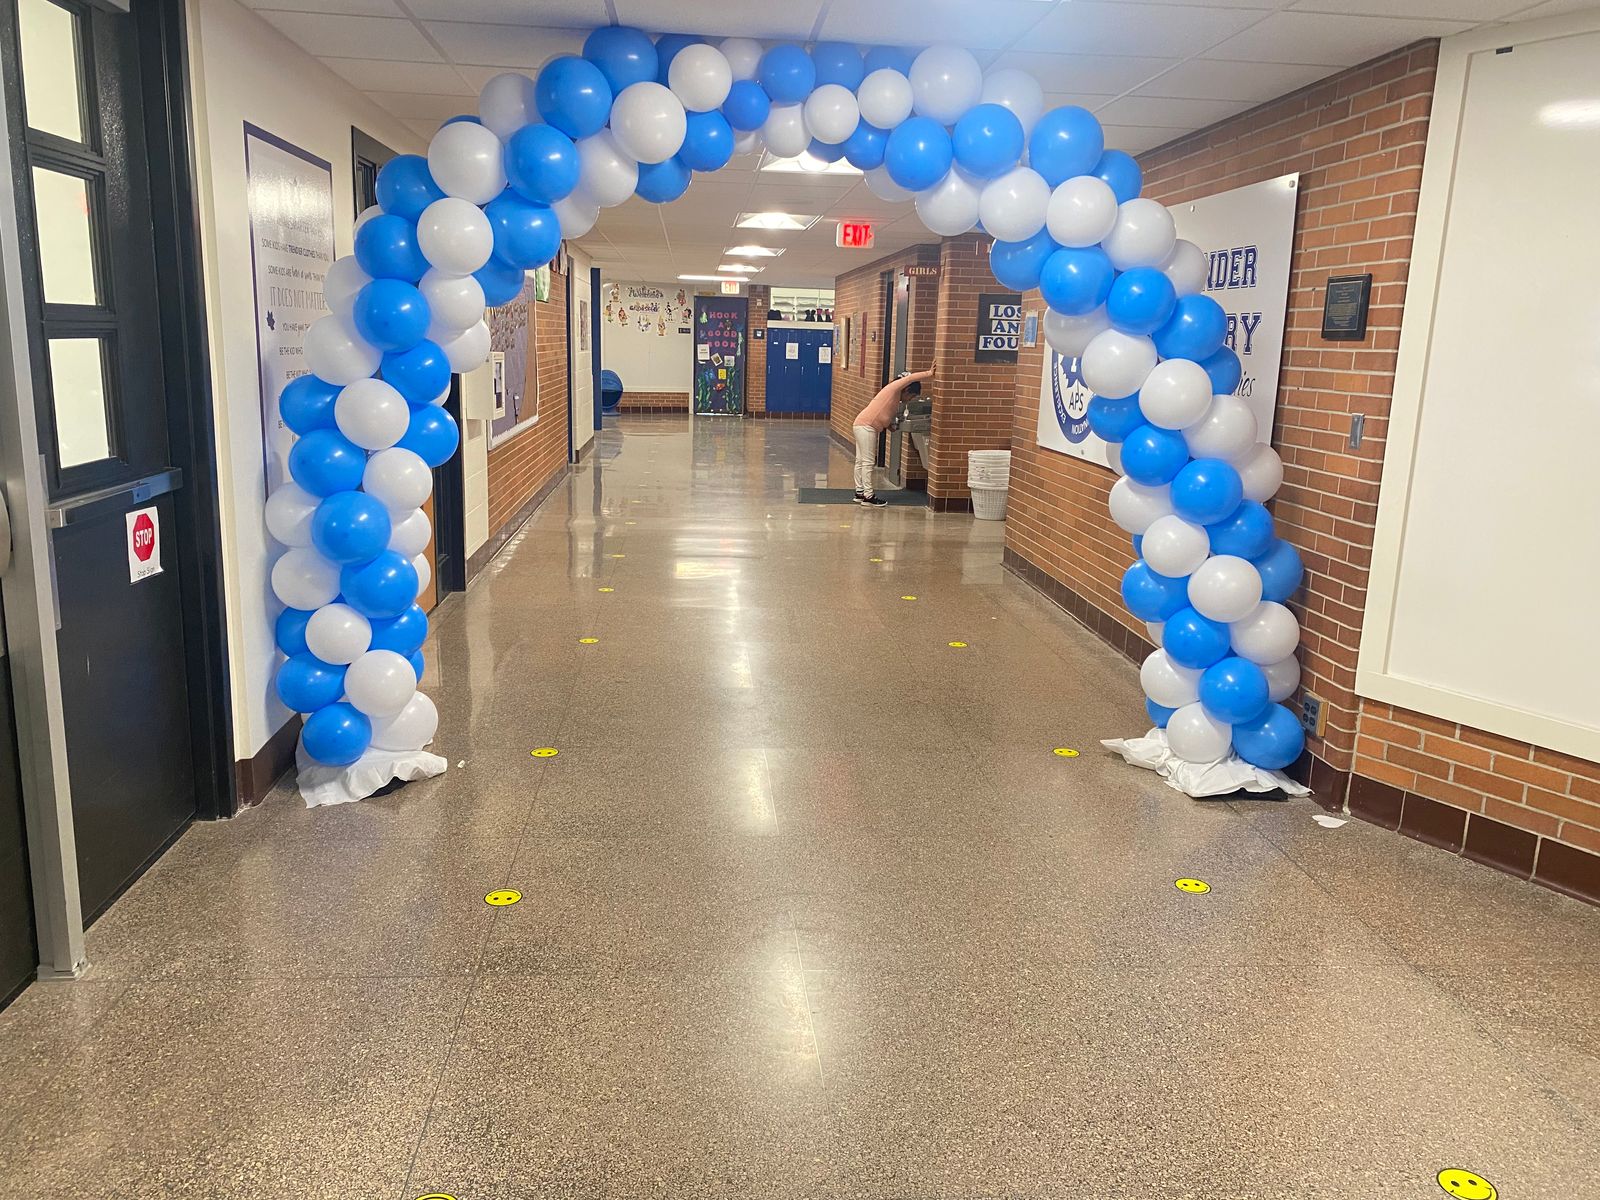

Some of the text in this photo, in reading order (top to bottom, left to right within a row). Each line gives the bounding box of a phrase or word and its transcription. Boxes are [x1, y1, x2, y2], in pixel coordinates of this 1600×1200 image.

[843, 224, 870, 246] EXIT
[909, 267, 937, 275] GIRLS
[707, 330, 737, 338] GOOD
[1225, 312, 1262, 355] RY
[1233, 371, 1256, 397] ies
[1069, 392, 1084, 411] APS
[135, 528, 152, 547] STOP
